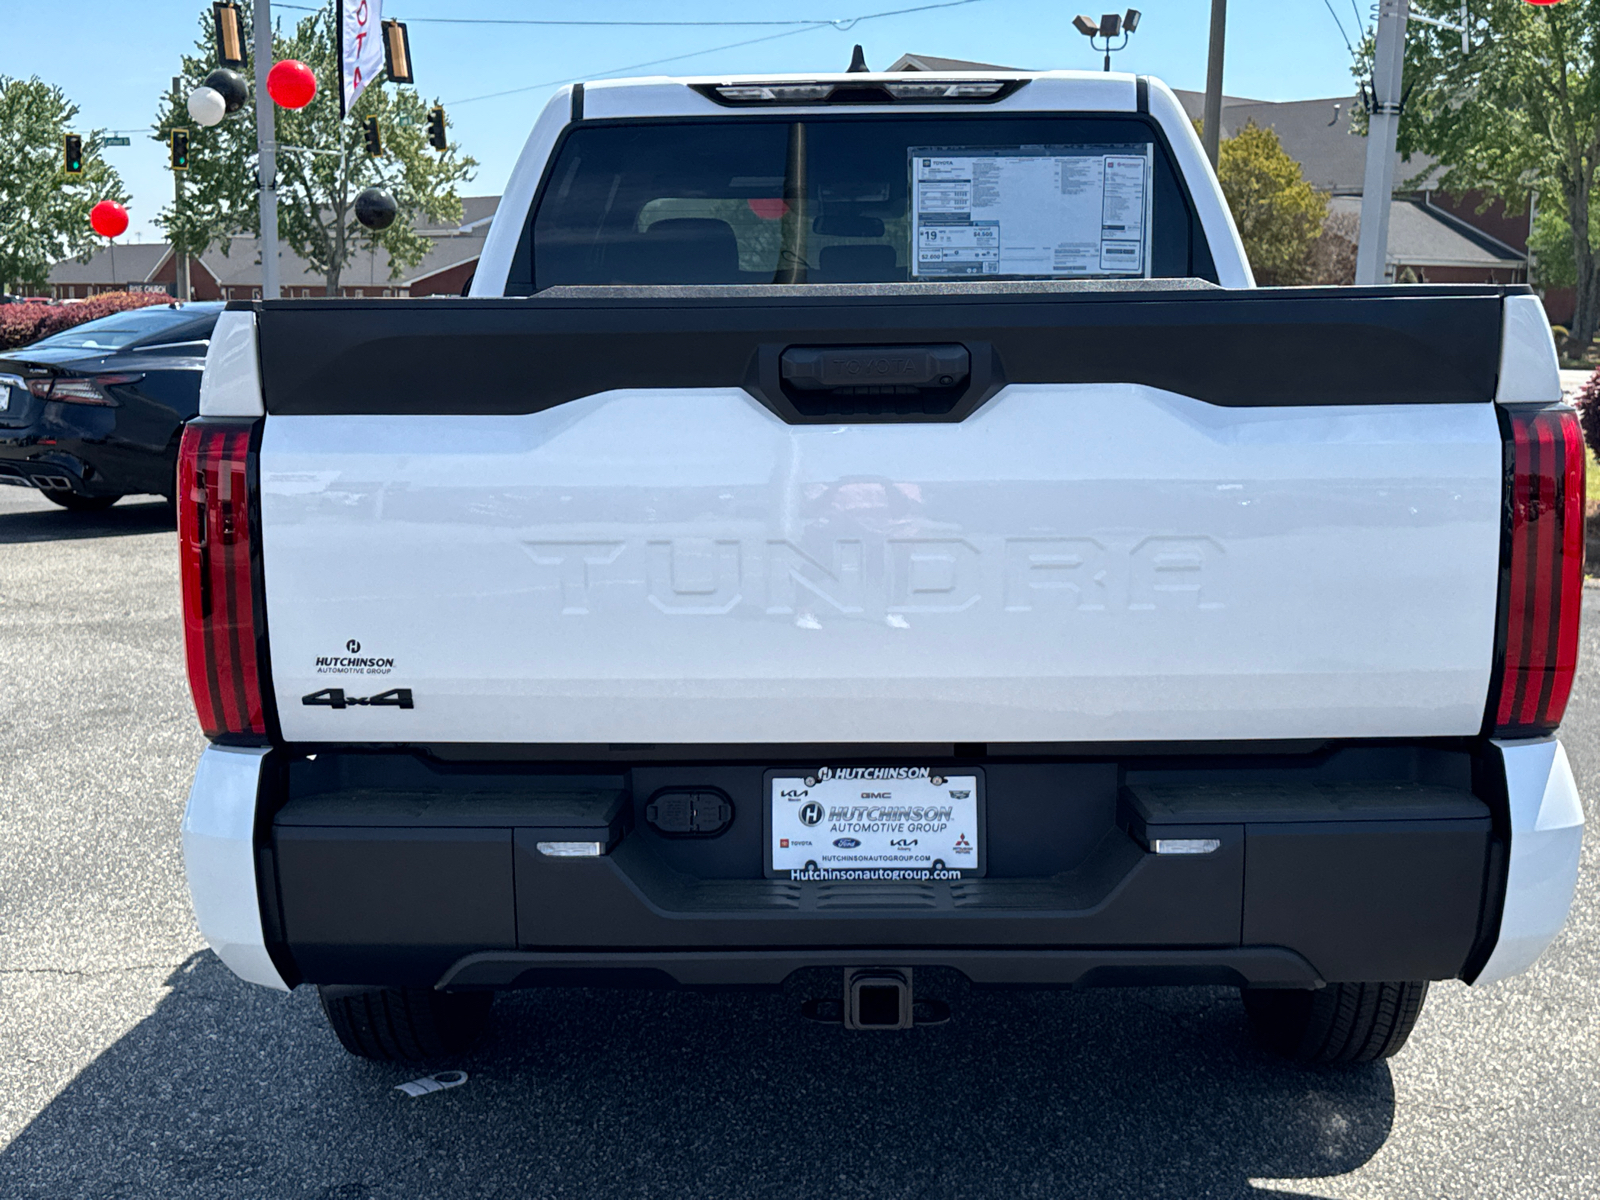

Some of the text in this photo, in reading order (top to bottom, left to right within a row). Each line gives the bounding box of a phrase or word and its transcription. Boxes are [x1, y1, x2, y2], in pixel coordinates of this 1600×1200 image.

[925, 230, 938, 241] 19
[144, 284, 167, 294] CHURCH
[833, 358, 917, 375] TOYOTA
[520, 536, 1226, 616] TUNDRA
[315, 656, 394, 667] HUTCHINSON
[317, 667, 365, 675] AUTOMOTIVE
[835, 767, 930, 780] HUTCHINSON
[828, 806, 952, 822] HUTCHINSON
[830, 823, 947, 833] AUTOMOTIVE GROUP
[822, 855, 931, 863] HUTCHINSONAUTOGROUP.COM
[790, 868, 961, 881] Hutchinsonautogroup.com
